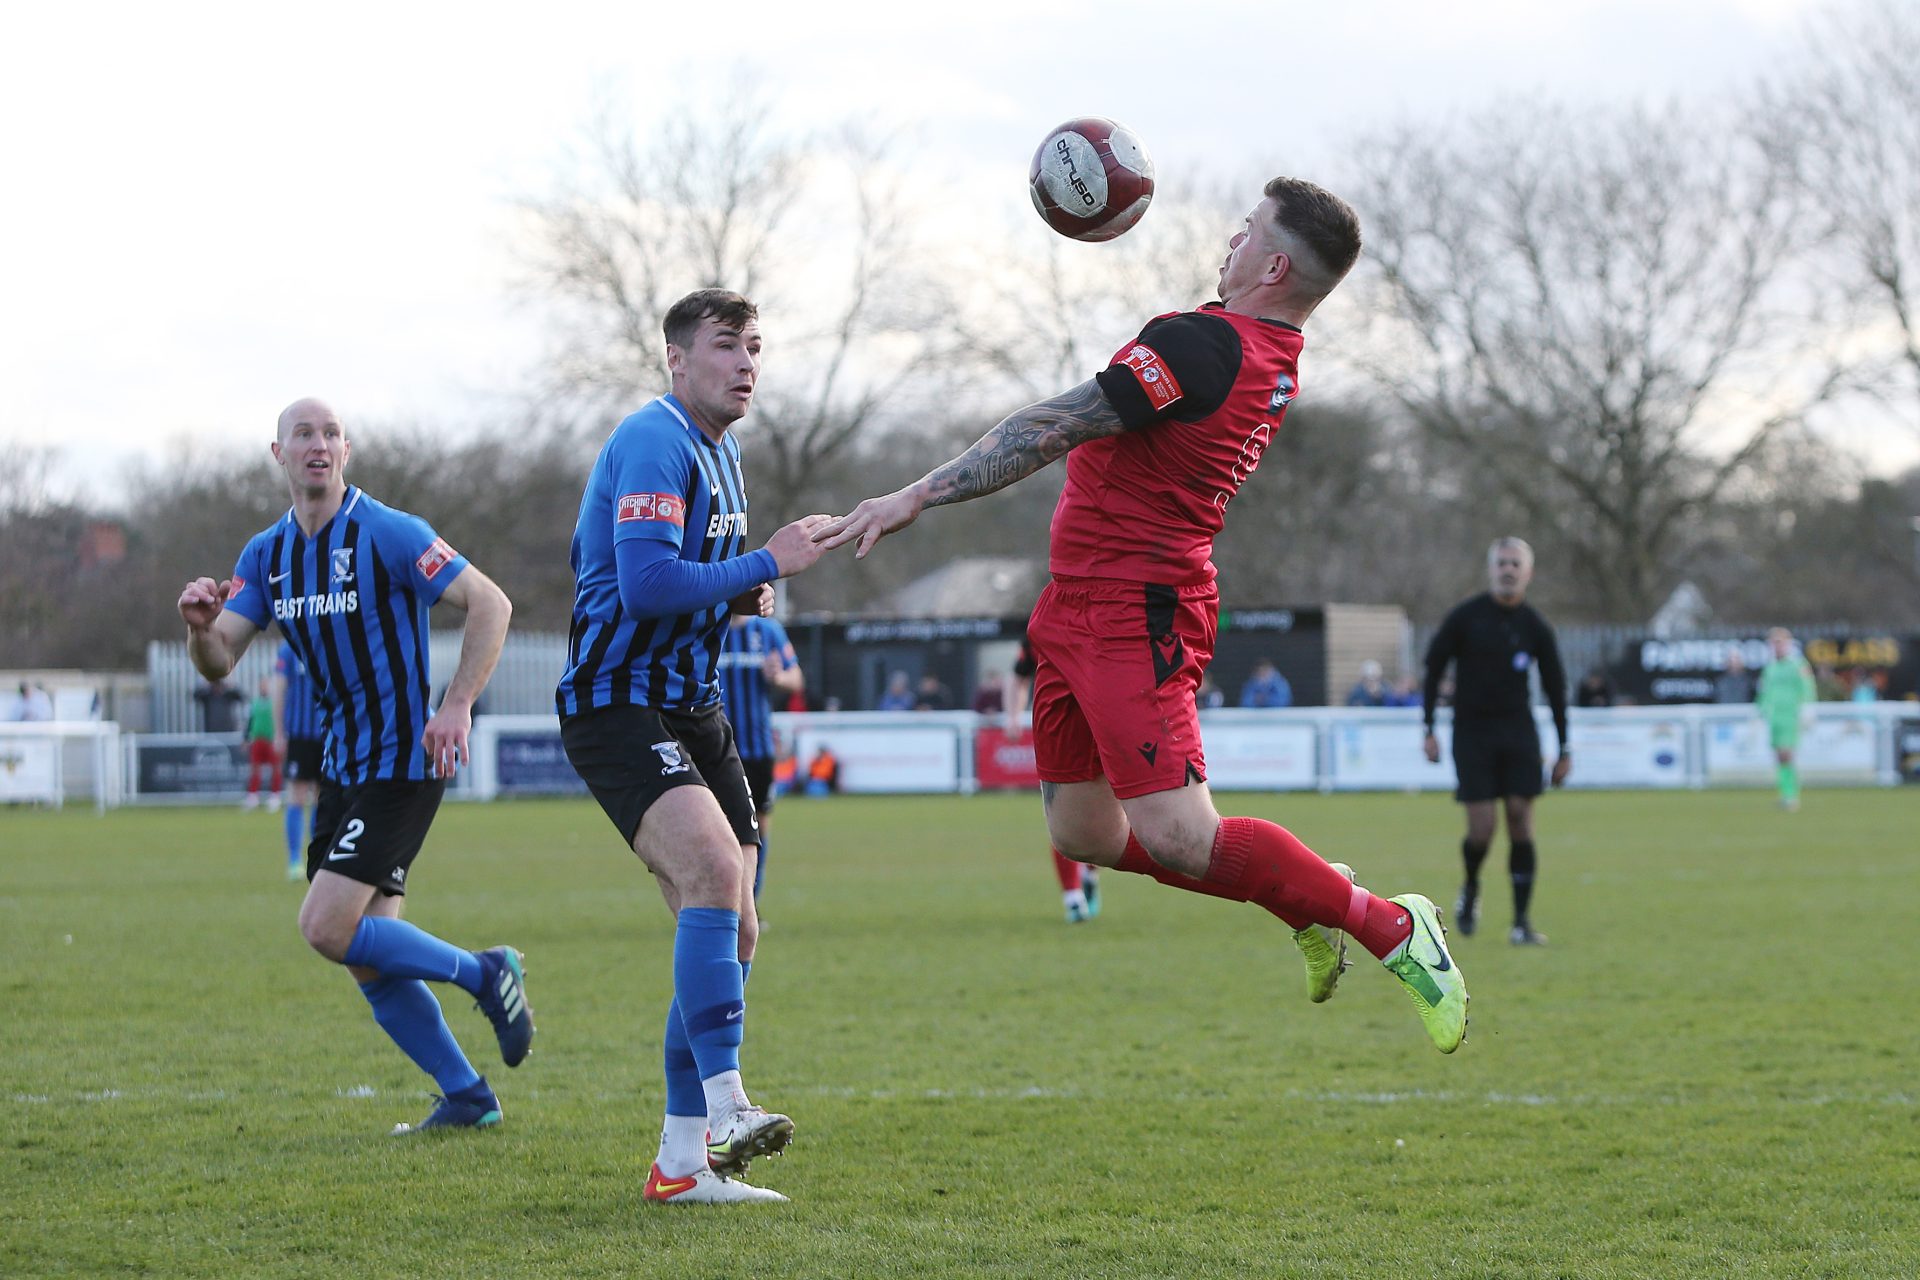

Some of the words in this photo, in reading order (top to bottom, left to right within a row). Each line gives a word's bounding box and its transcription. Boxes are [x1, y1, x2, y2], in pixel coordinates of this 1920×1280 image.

[1056, 138, 1096, 206] chryso
[1167, 383, 1177, 396] WITH
[706, 513, 736, 538] EAST
[735, 511, 748, 537] TR
[273, 596, 305, 620] EAST
[308, 590, 358, 616] TRANS
[338, 818, 365, 852] 2
